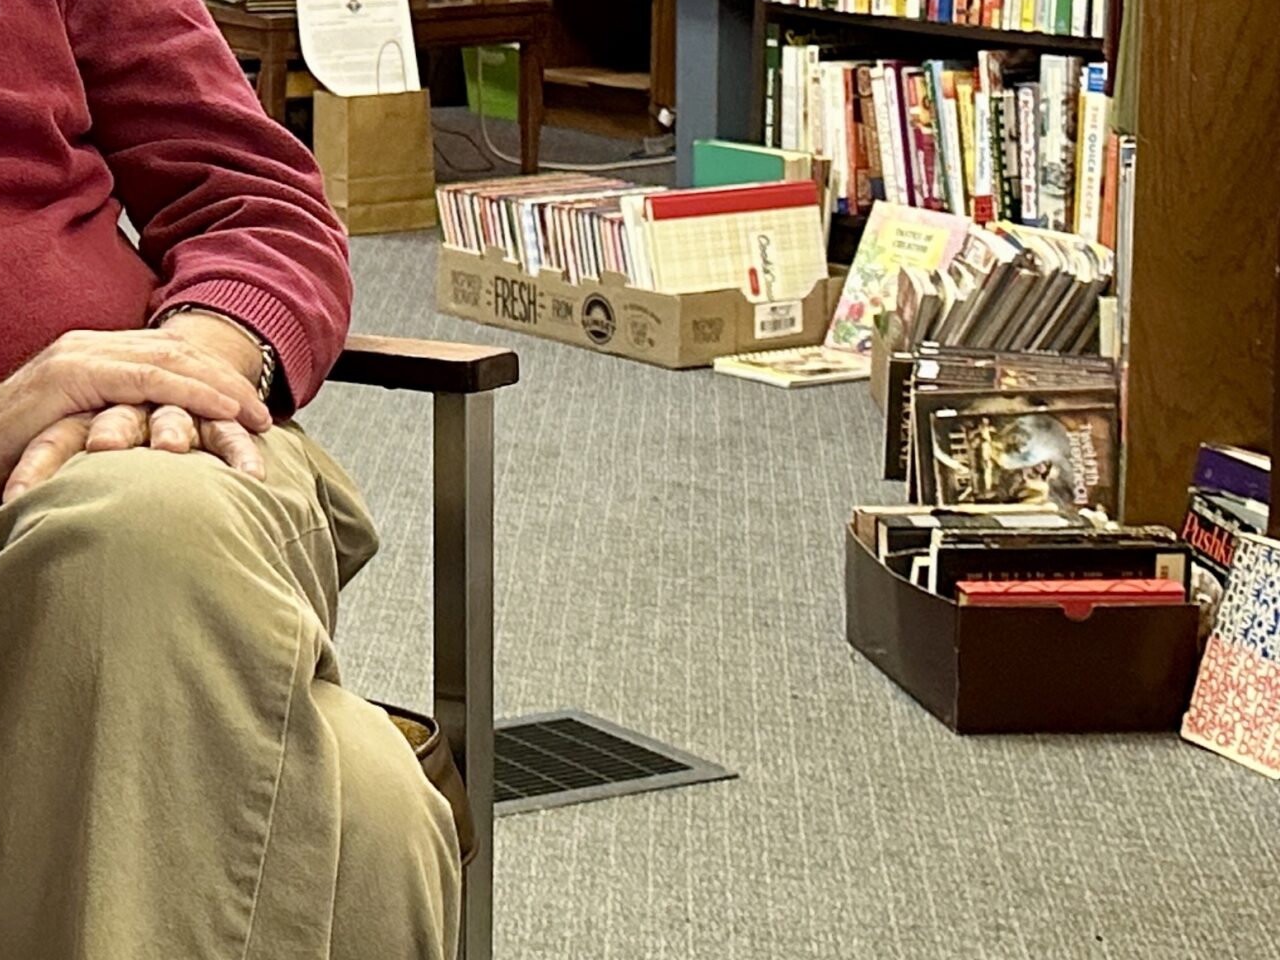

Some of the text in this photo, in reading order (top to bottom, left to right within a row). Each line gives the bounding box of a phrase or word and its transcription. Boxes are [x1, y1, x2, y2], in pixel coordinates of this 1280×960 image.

[1085, 106, 1098, 220] THE QUICK RECIPE
[494, 276, 537, 325] FRESH
[1182, 510, 1237, 569] Pushki
